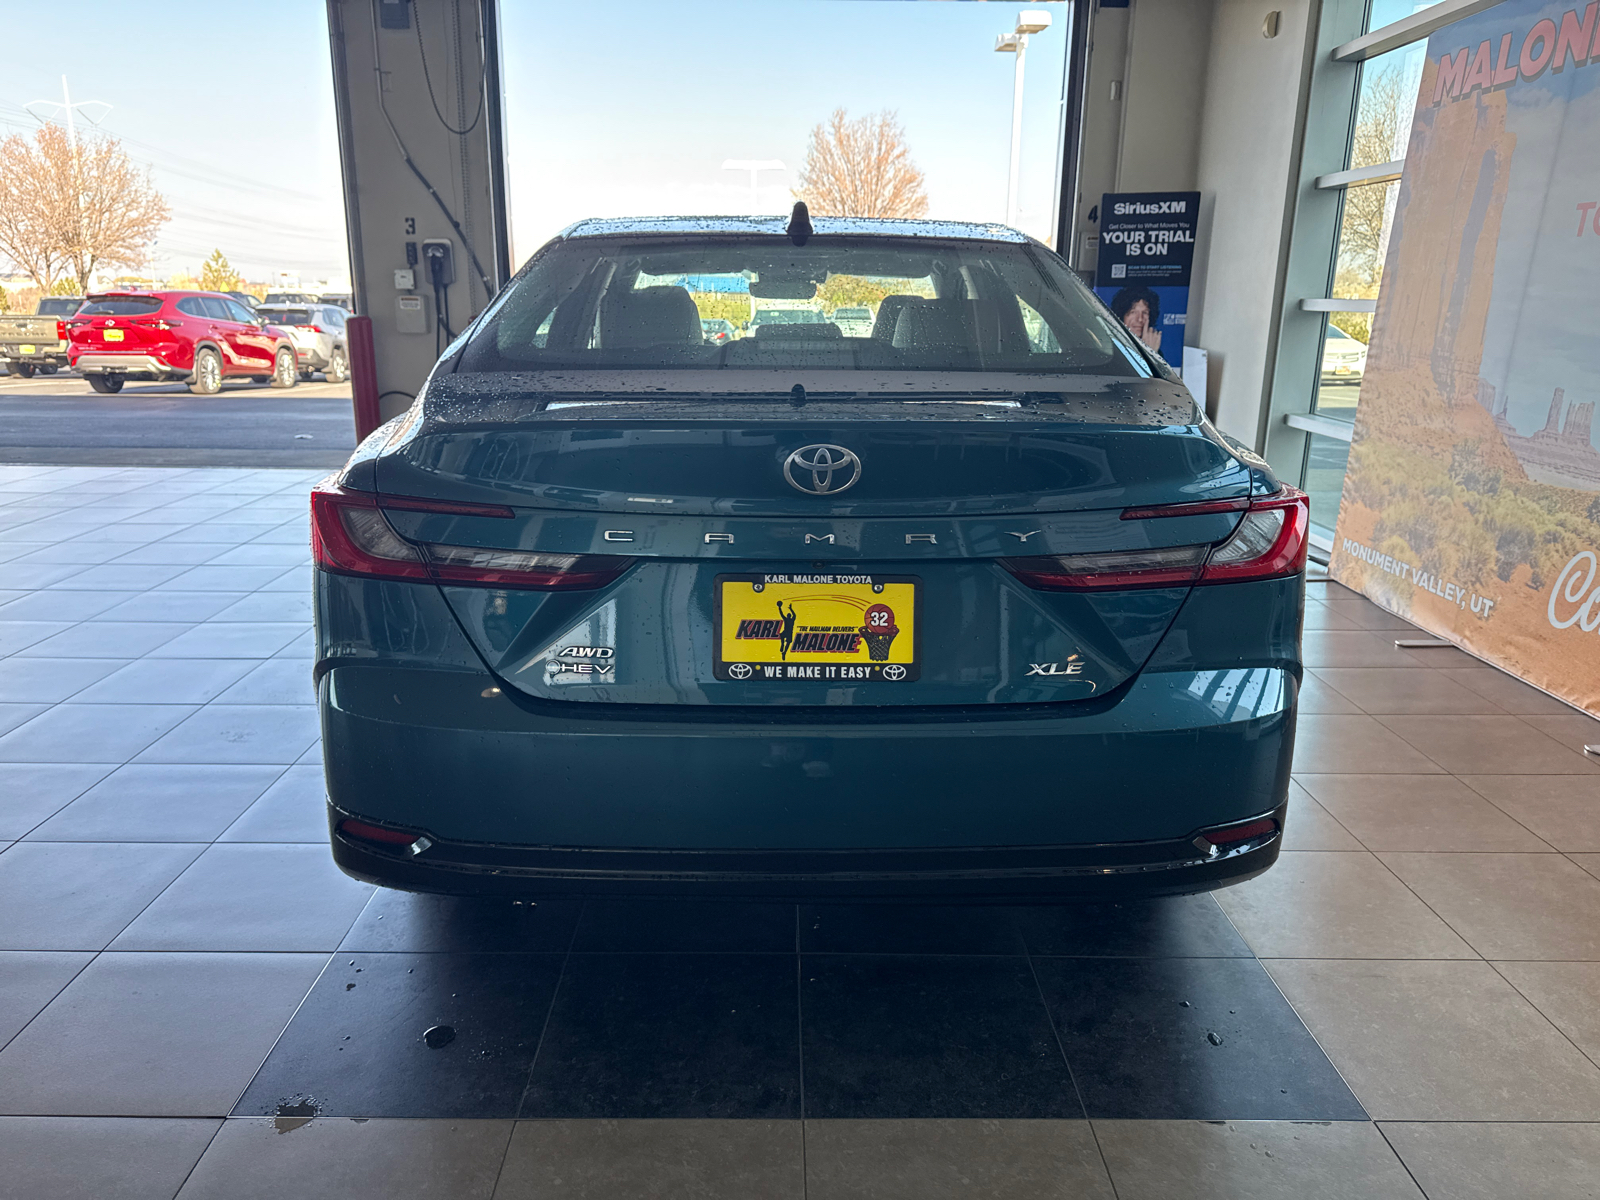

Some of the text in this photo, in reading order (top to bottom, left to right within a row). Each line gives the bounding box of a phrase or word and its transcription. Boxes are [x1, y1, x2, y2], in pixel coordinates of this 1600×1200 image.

[1088, 205, 1099, 223] 4
[1114, 201, 1186, 215] SiriusXM
[405, 217, 416, 235] 3
[1103, 231, 1145, 244] YOUR
[1148, 230, 1194, 243] TRIAL
[1126, 243, 1168, 256] IS ON
[604, 529, 1042, 545] CAMRY
[764, 575, 872, 585] KARL MALONE TOYOTA
[1343, 538, 1494, 618] MONUMENT VALLEY, UT
[870, 612, 888, 627] 32
[735, 619, 783, 639] KARL
[791, 633, 862, 653] MALONE
[559, 647, 614, 658] AWD
[560, 663, 612, 674] HEV
[764, 666, 871, 678] WE MAKE IT EASY
[1024, 662, 1086, 676] XLE
